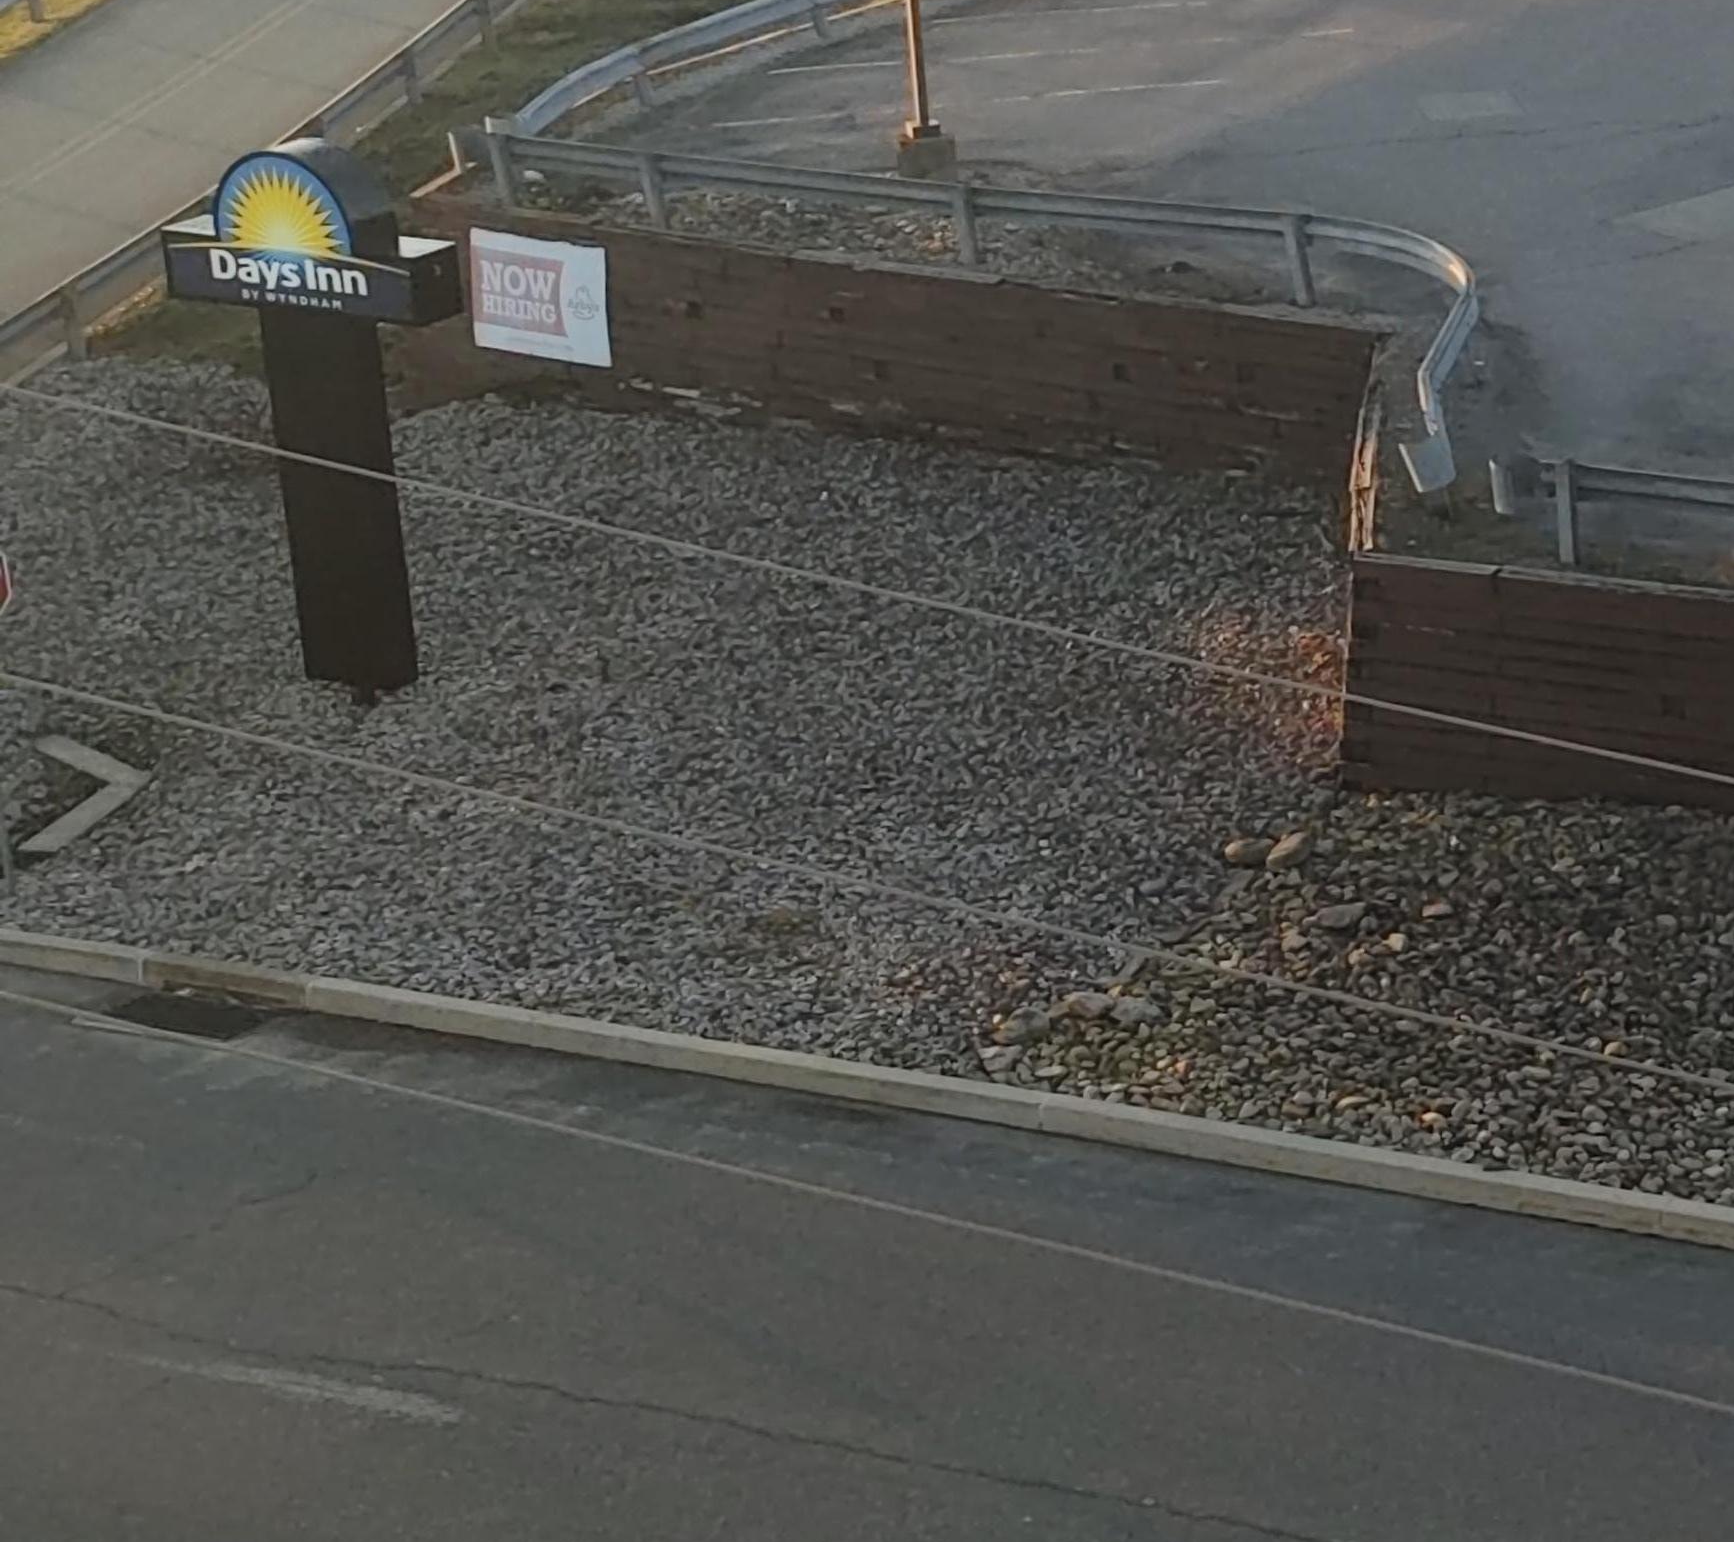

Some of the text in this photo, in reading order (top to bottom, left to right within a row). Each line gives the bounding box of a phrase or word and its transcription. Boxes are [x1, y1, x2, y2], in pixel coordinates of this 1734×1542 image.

[208, 247, 369, 297] Days Inn
[480, 259, 557, 302] NOW
[240, 287, 344, 310] BY WYNDHAM
[482, 292, 557, 324] HIRING
